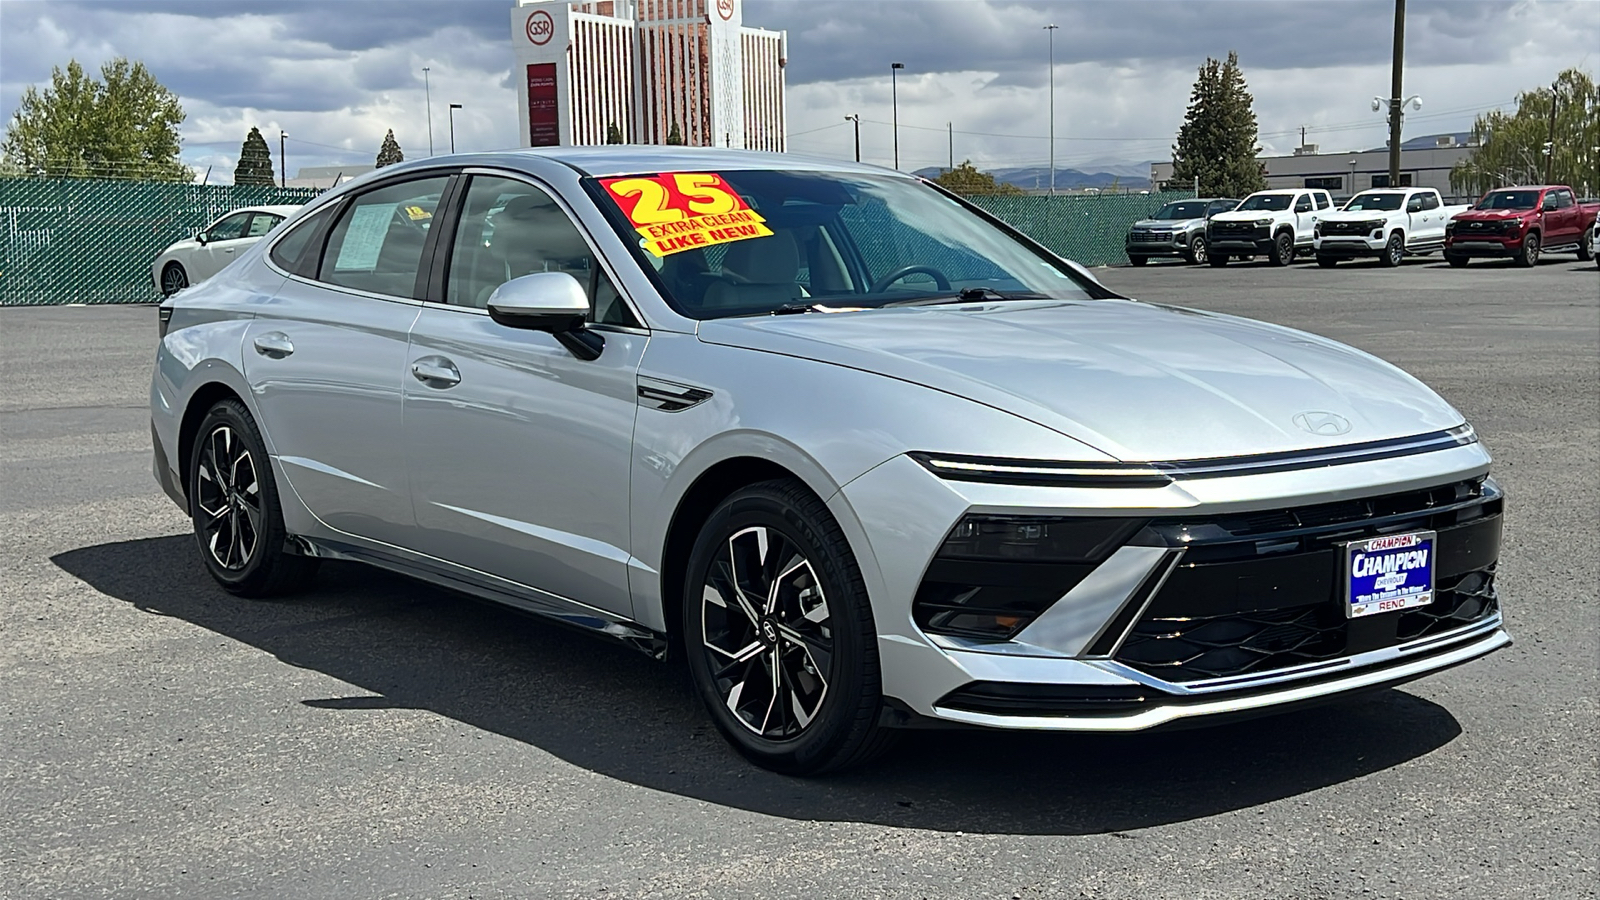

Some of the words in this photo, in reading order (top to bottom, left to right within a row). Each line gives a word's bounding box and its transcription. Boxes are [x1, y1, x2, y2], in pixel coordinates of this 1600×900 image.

[530, 20, 550, 35] GSR
[609, 173, 739, 224] 25
[647, 220, 702, 238] EXTRA
[704, 212, 754, 229] CLEAN
[656, 233, 706, 253] LIKE
[708, 224, 758, 241] NEW
[1371, 536, 1412, 550] CHAMPION
[1376, 575, 1405, 587] CHEVROLET
[1379, 598, 1406, 611] RENO
